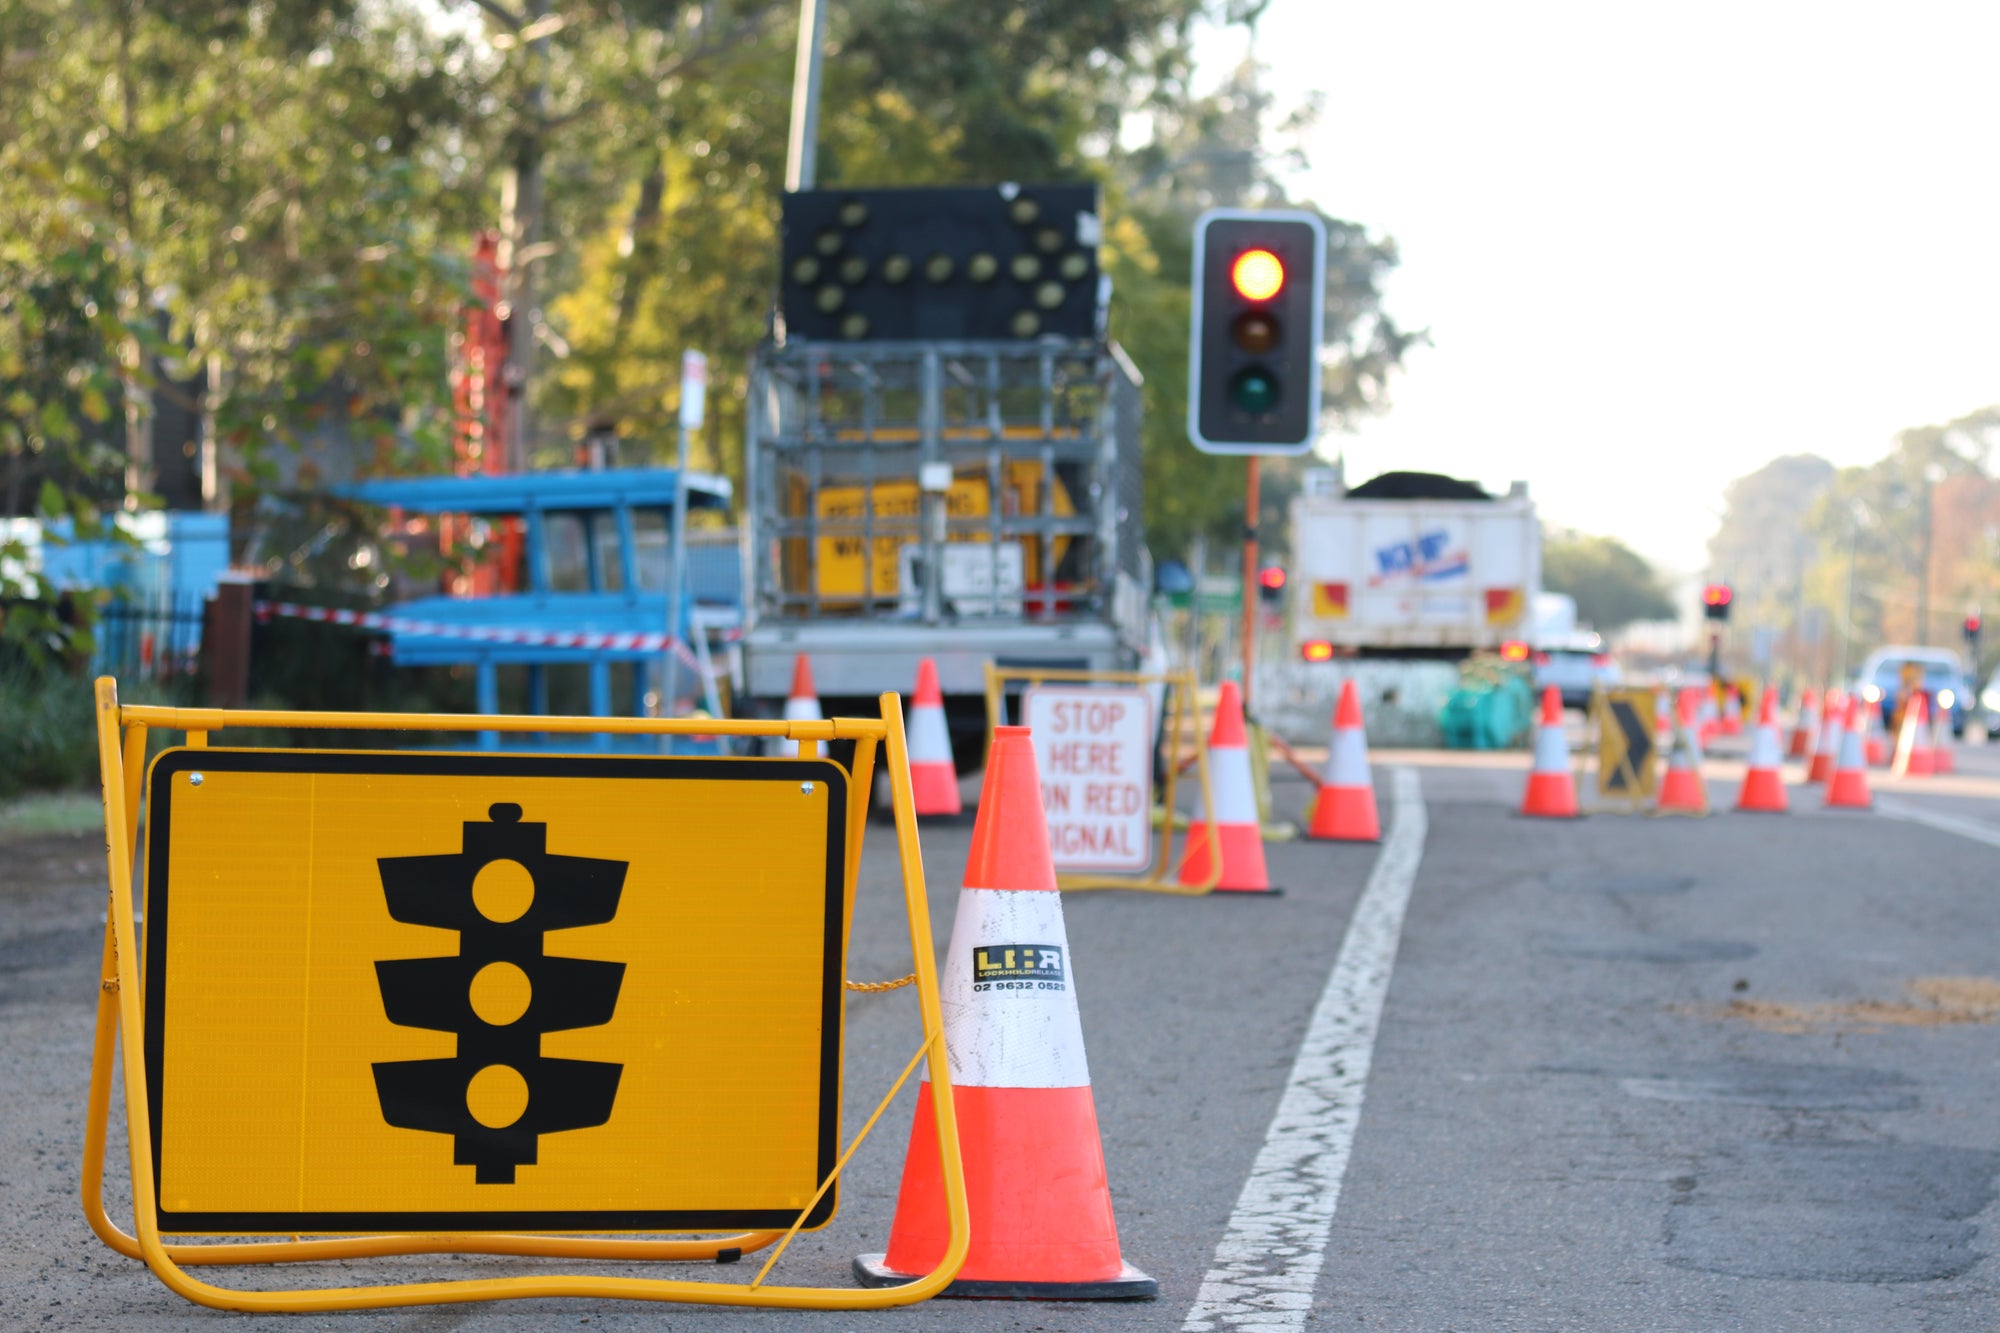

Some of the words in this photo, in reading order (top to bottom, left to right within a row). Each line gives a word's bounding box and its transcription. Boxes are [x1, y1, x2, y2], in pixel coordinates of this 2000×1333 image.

[1052, 702, 1125, 734] STOP
[1049, 742, 1123, 775] HERE
[1084, 782, 1142, 816] RED
[1050, 824, 1133, 857] IGNAL
[974, 984, 991, 992] 02
[996, 982, 1034, 990] 9632
